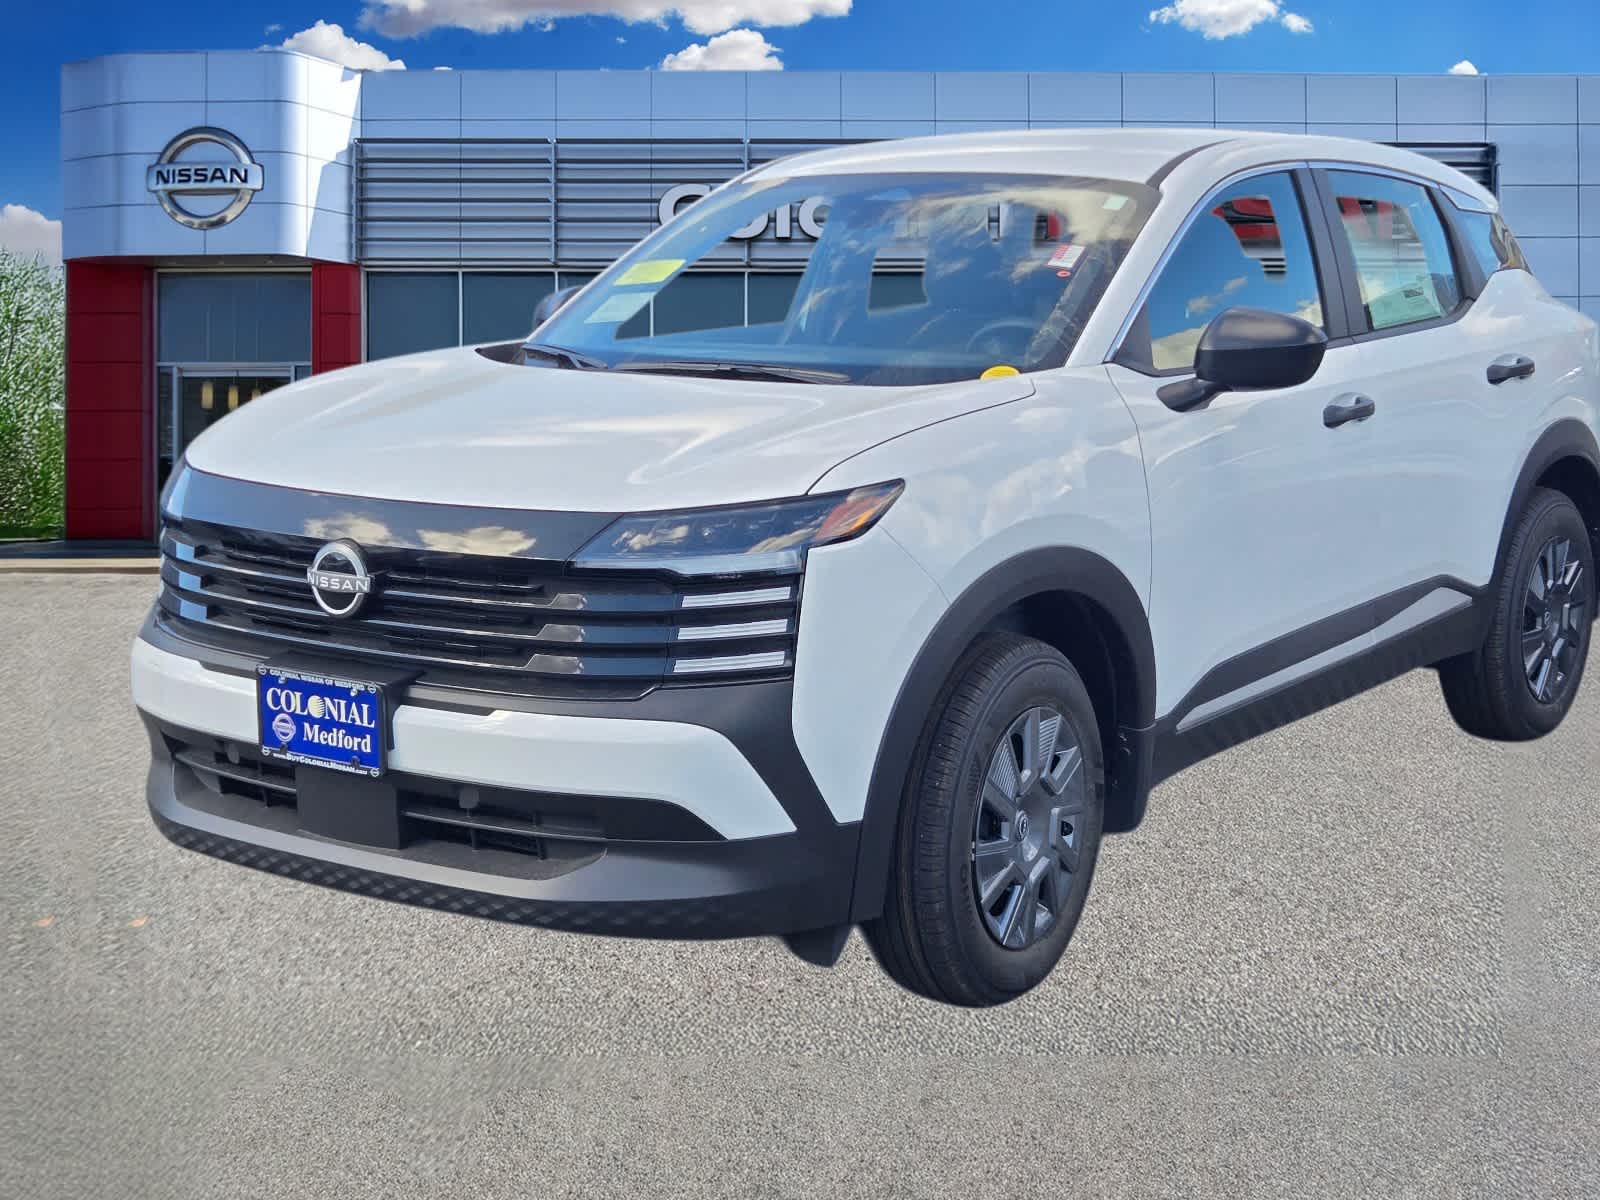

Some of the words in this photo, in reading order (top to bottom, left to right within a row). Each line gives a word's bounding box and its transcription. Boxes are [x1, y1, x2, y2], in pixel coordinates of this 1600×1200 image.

[156, 167, 248, 185] NISSAN
[307, 572, 367, 592] NISSAN
[267, 688, 375, 728] COLONIAL
[303, 722, 371, 753] Medford
